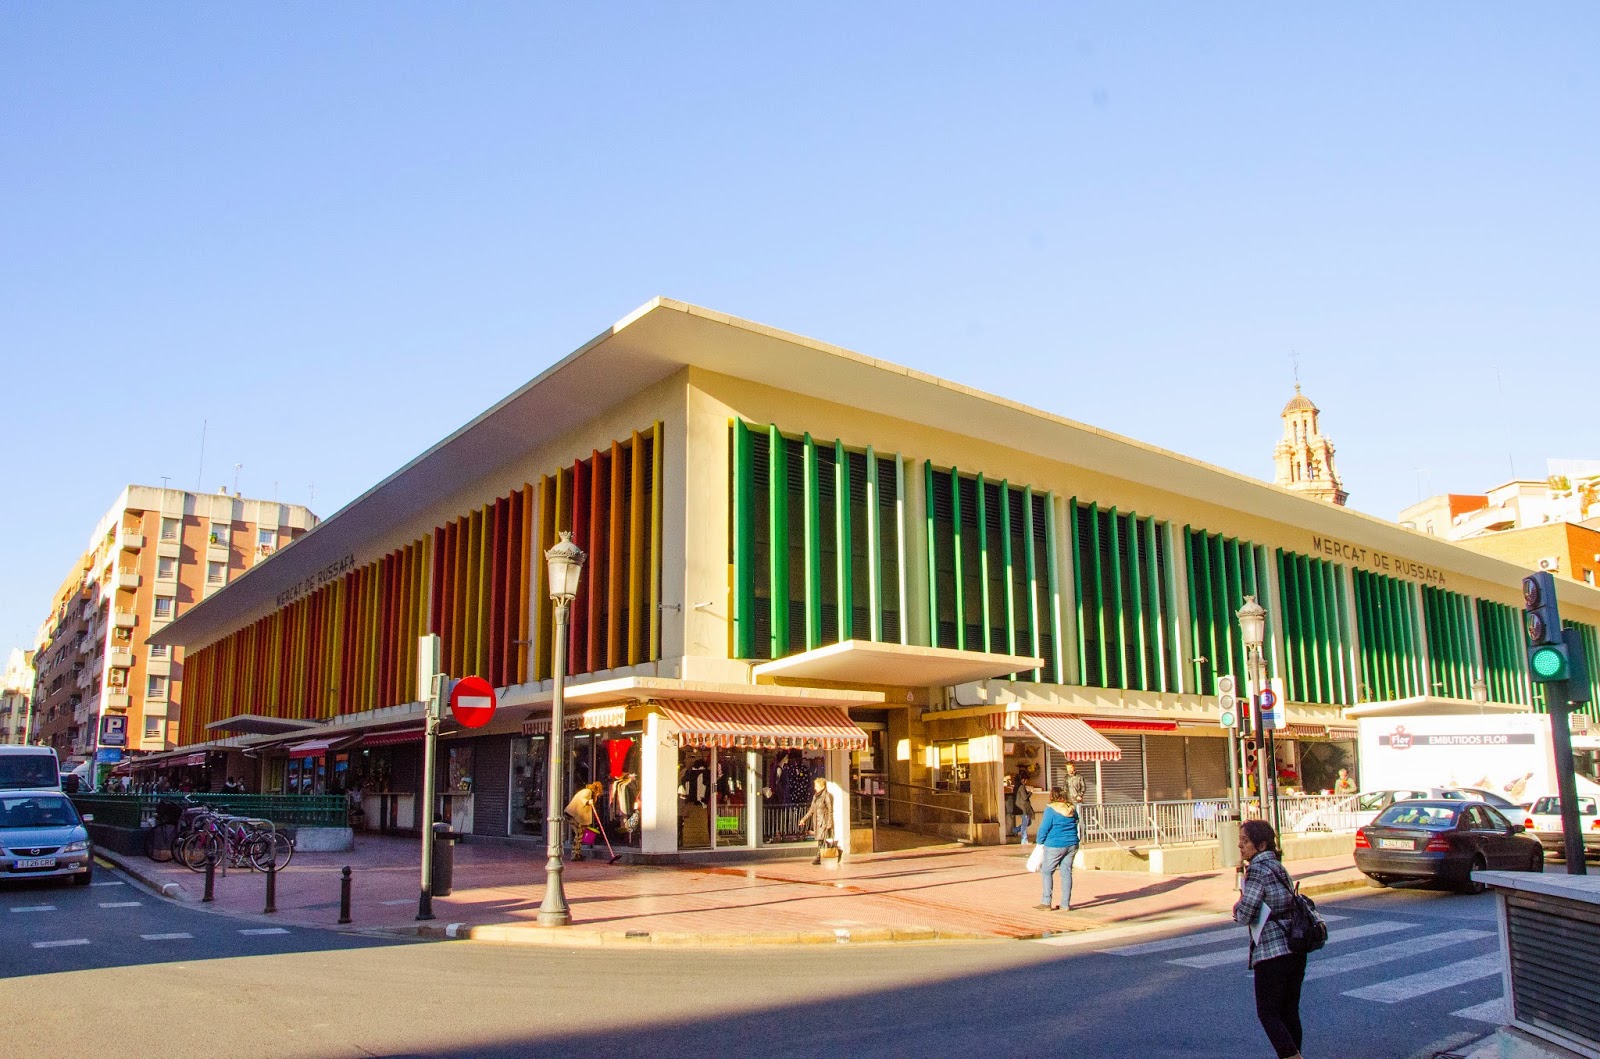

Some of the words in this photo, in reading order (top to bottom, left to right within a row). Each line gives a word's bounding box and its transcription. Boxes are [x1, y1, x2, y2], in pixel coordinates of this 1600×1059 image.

[1312, 535, 1366, 563] MERCAT
[1373, 553, 1390, 570] DE
[1395, 559, 1446, 584] RUSSAFA
[305, 575, 315, 592] DE
[318, 554, 355, 582] RUSSAFA
[107, 718, 122, 733] P
[1391, 734, 1410, 744] Flor
[1428, 735, 1482, 745] EMBUTIDOS
[1483, 735, 1508, 744] FLOR
